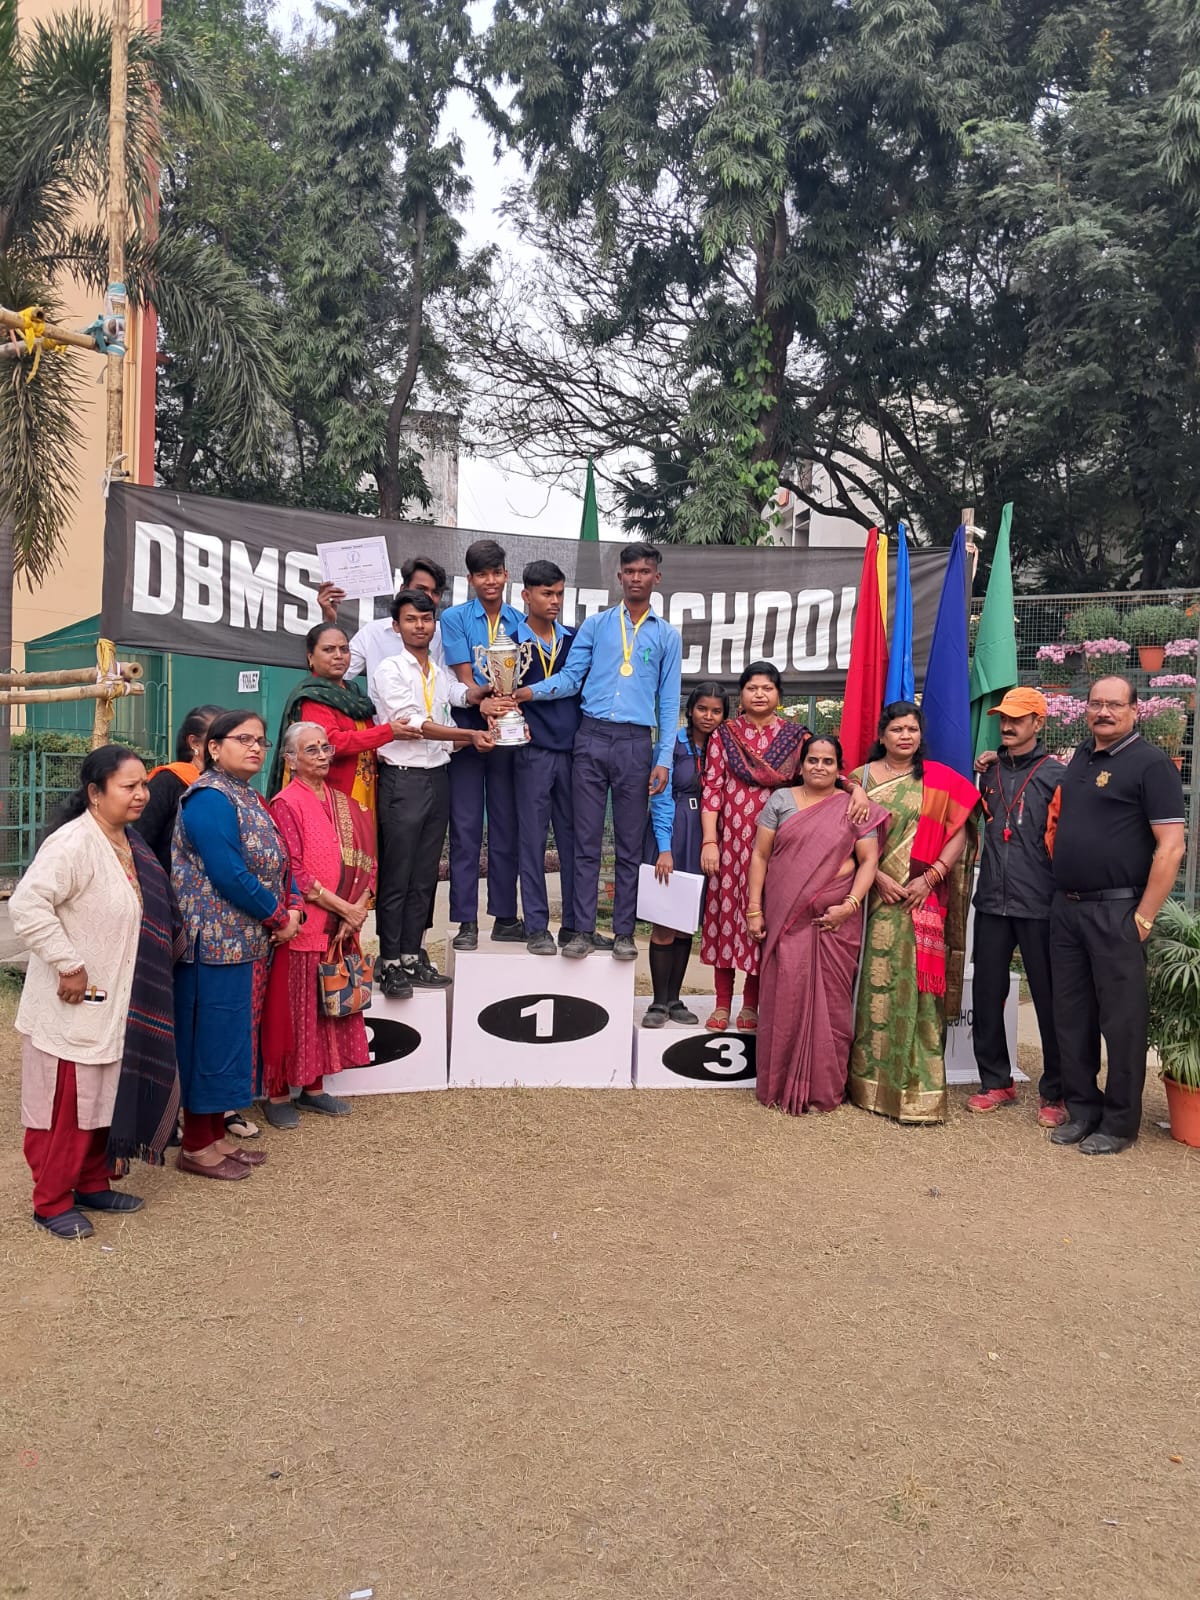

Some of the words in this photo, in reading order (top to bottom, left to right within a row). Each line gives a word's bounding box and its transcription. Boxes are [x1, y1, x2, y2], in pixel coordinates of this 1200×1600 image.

[132, 520, 324, 637] DBMS
[520, 998, 555, 1038] 1
[702, 1037, 748, 1075] 3
